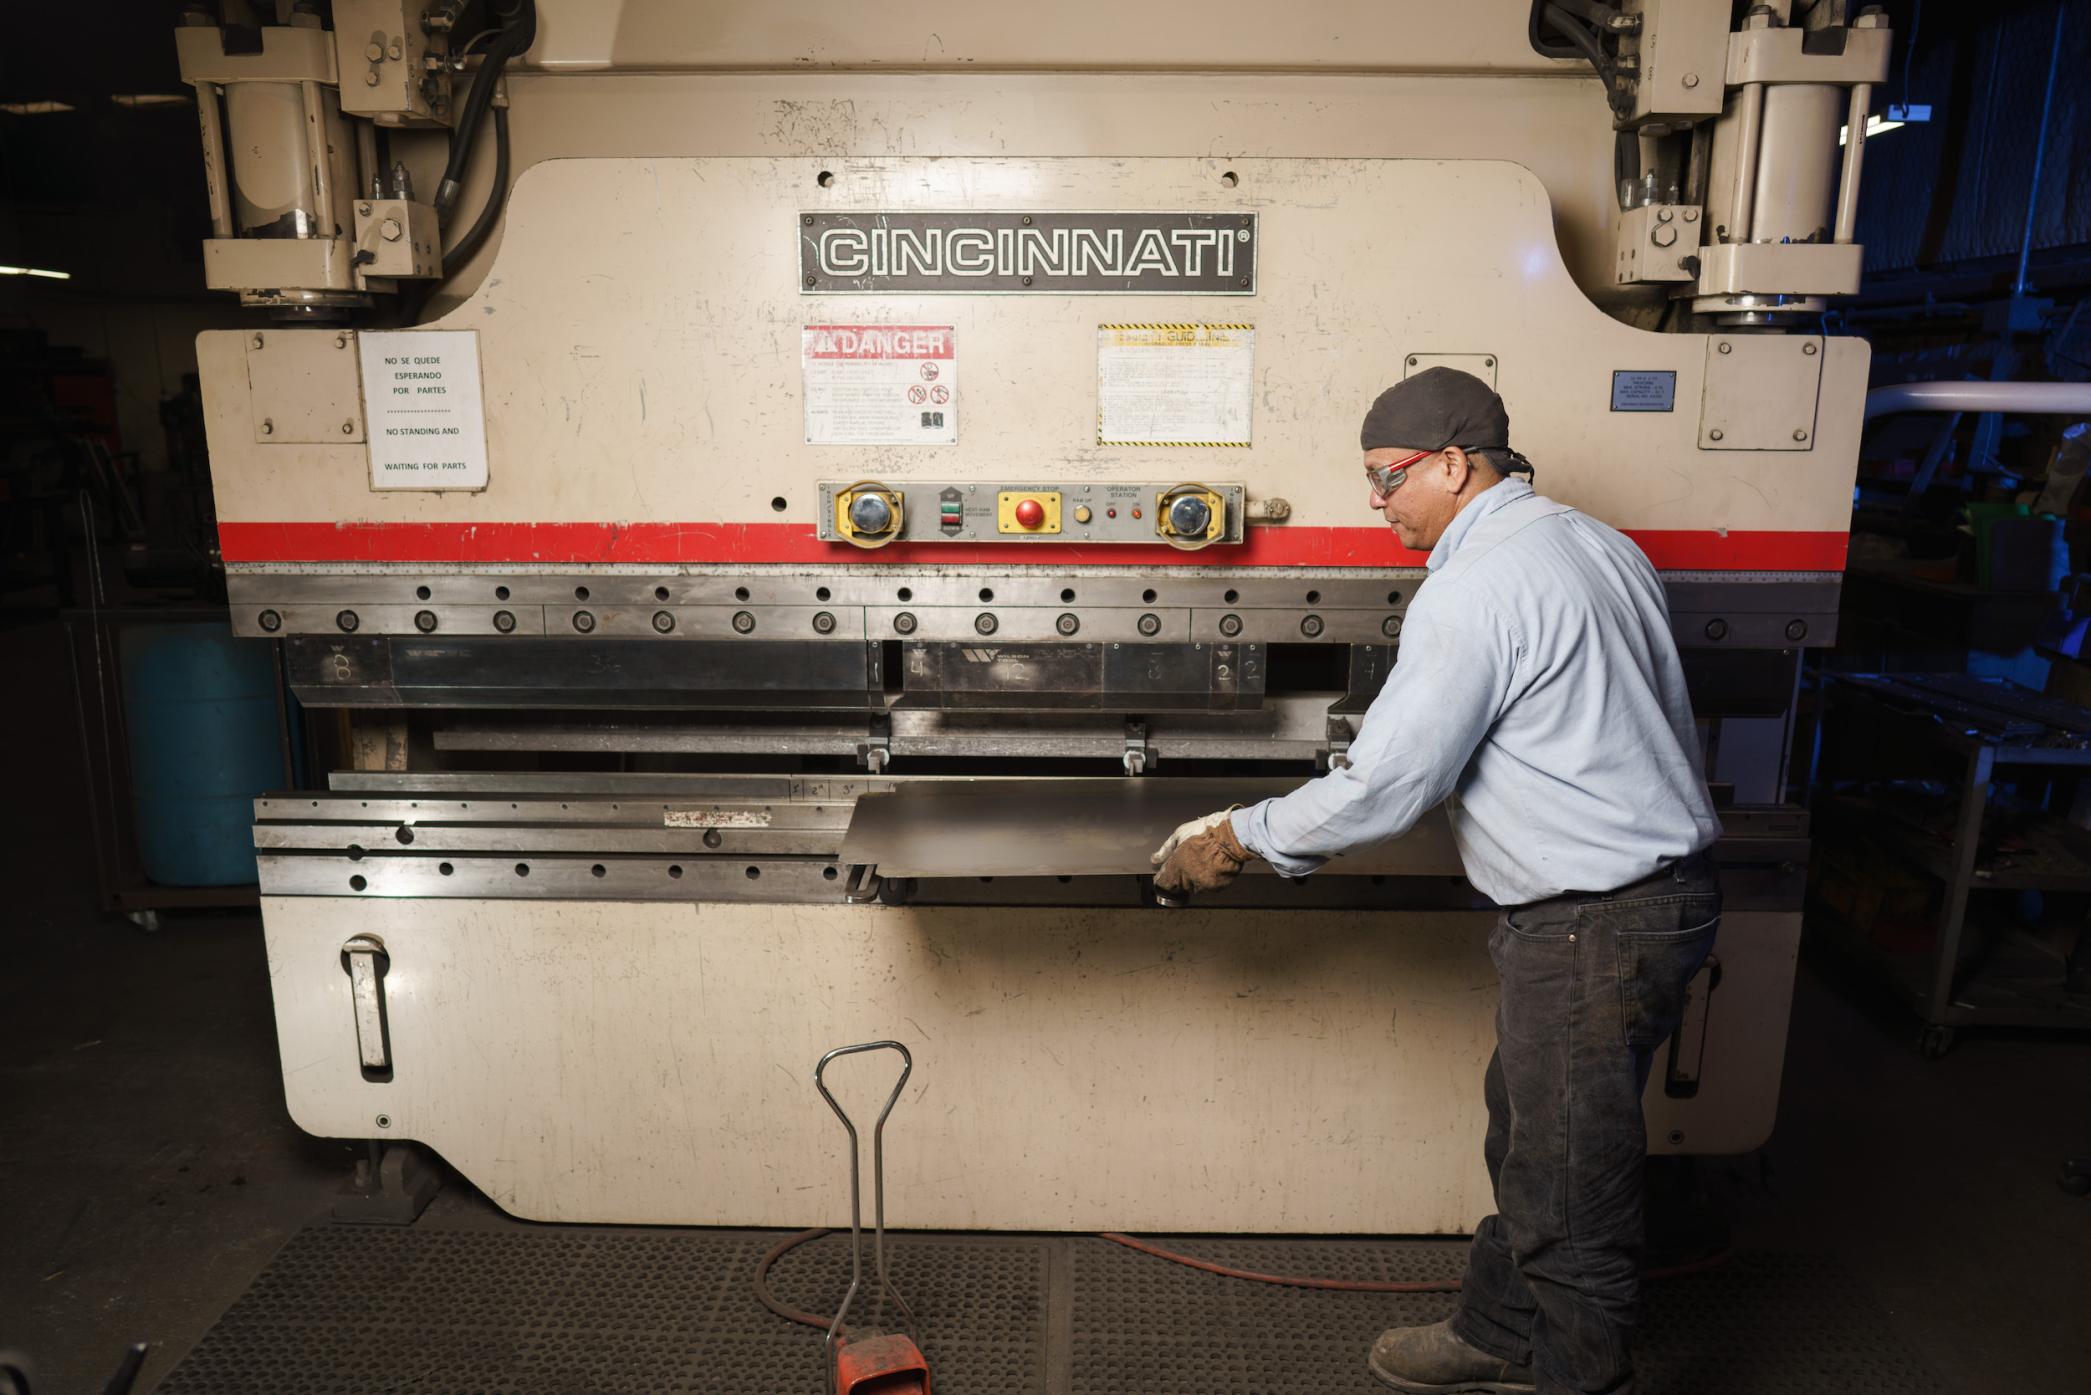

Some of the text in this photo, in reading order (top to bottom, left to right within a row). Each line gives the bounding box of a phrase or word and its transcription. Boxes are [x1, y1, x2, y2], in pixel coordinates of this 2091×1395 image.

[841, 331, 945, 354] DANGER
[384, 356, 441, 365] NO SE QUEDE
[394, 372, 442, 380] ESPERANDO
[393, 386, 447, 395] POR PARTES
[400, 428, 440, 436] STANDING
[385, 463, 419, 471] WAITING
[442, 462, 466, 470] PARTS
[910, 660, 924, 677] 4
[1005, 662, 1031, 682] 12
[1217, 664, 1232, 681] 2
[1244, 660, 1261, 680] 2
